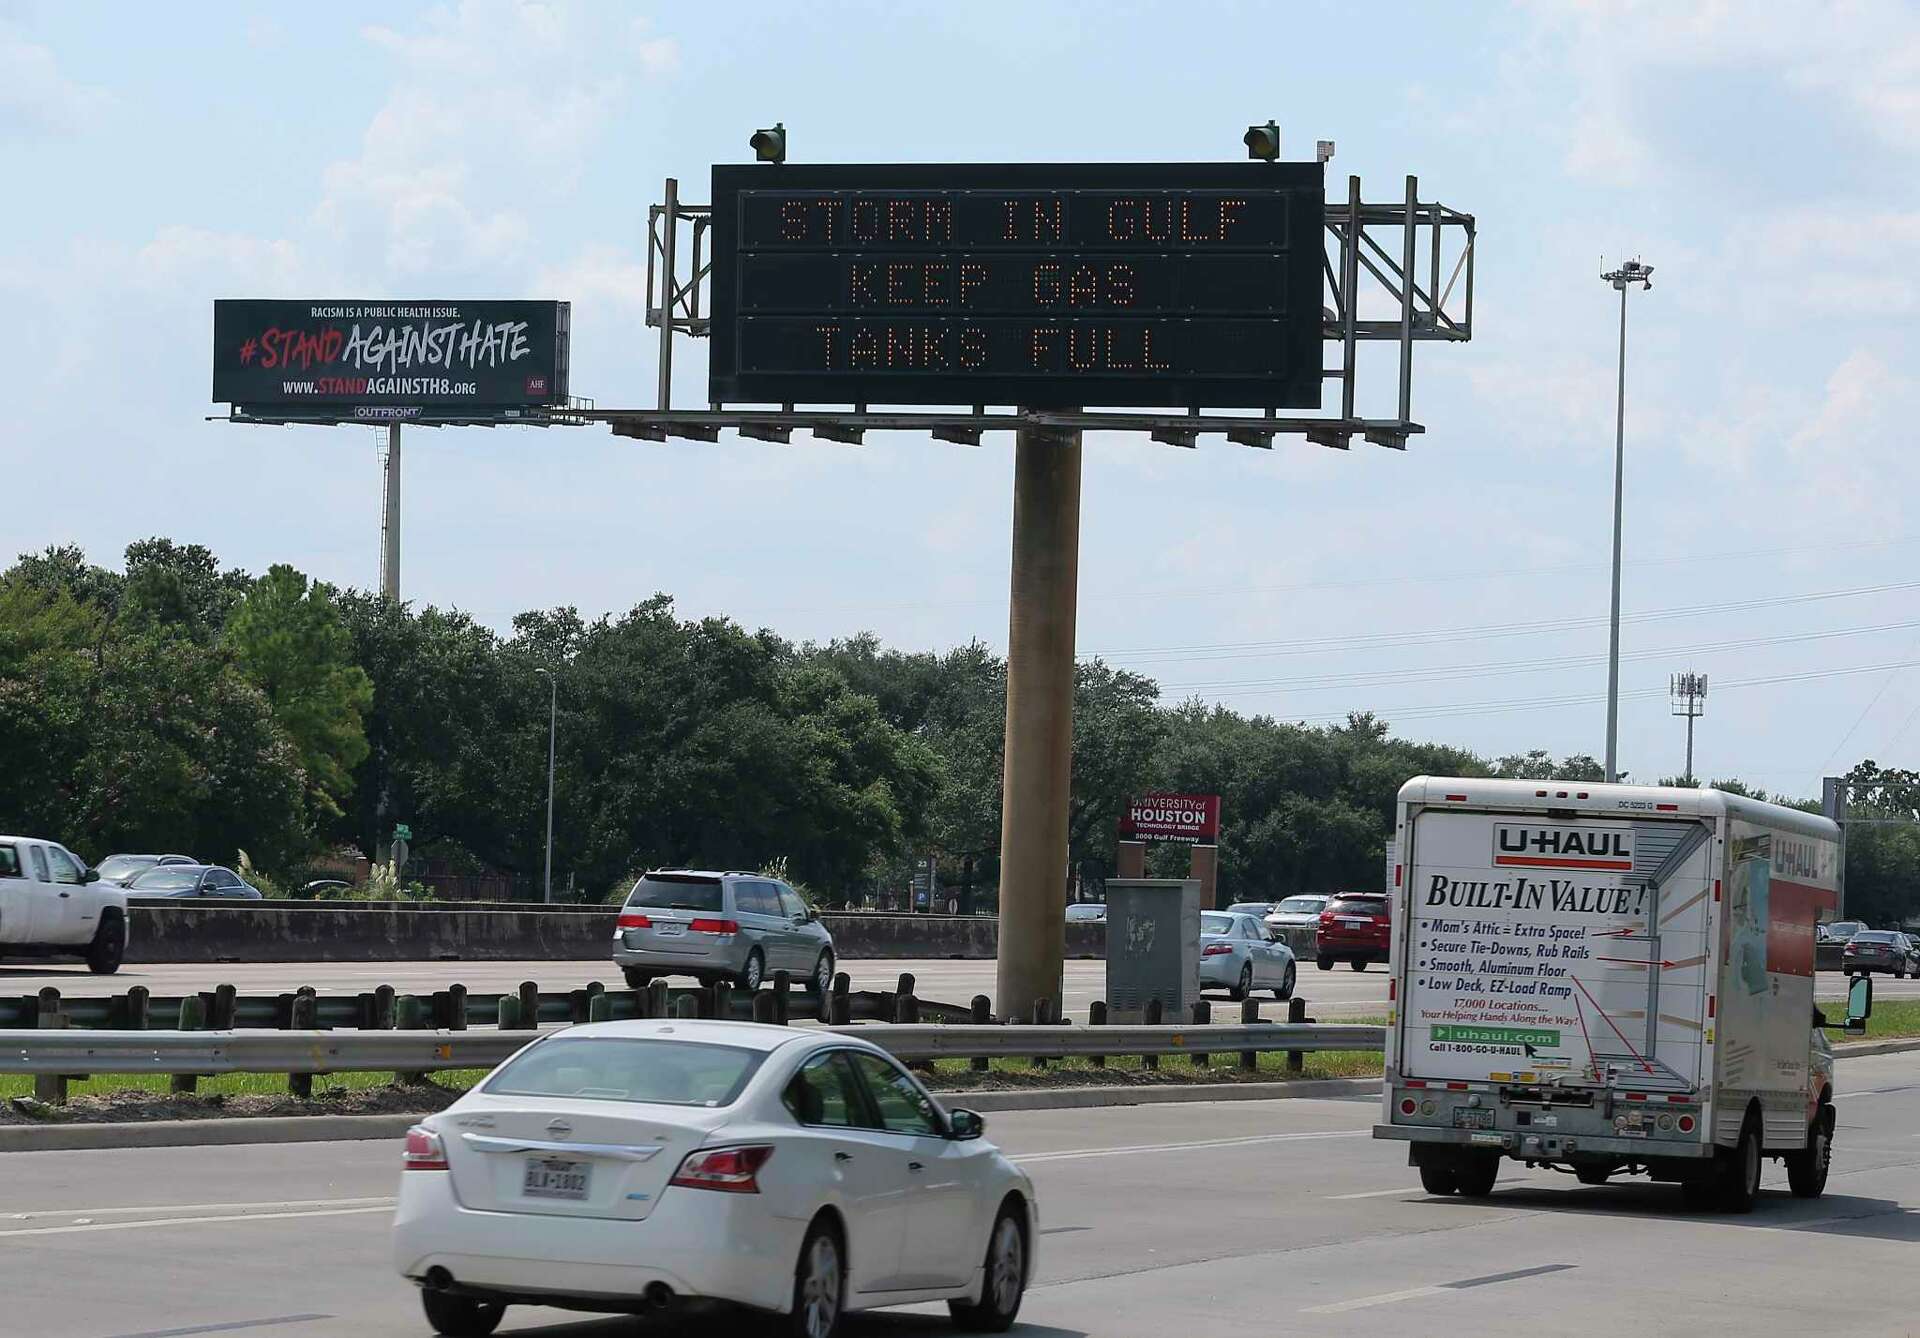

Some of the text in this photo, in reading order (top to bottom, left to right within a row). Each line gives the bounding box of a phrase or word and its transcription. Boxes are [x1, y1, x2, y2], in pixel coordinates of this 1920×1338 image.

[780, 200, 1247, 241] STORM IN GULF
[851, 264, 1133, 304] KEEP GAS
[311, 307, 461, 318] RACISM IS A PUBLIC HEALTH ISSUE.
[816, 326, 1171, 368] TANKS FULL
[357, 407, 418, 417] OUTFRONT
[1131, 808, 1205, 824] HOUSTON
[1136, 822, 1176, 830] TECHNOLOGY
[1169, 834, 1200, 843] Freeway
[1500, 829, 1630, 856] U-HAUL
[1431, 919, 1470, 934] Mom's
[1473, 921, 1500, 935] Attic
[1514, 923, 1545, 938] Extra
[1549, 925, 1586, 941] Space!
[1430, 939, 1590, 960] Secure Tie-Downs, Rub Rails
[1429, 957, 1567, 977] Smooth, Aluminum Floor
[1428, 977, 1572, 999] Low Deck, EZ-Load Ramp
[1421, 1010, 1579, 1026] Your Helping Hands Along the Way!
[1456, 1030, 1553, 1043] uhaul.com
[1429, 1043, 1522, 1056] Call 1-800-GO-U-HAUL
